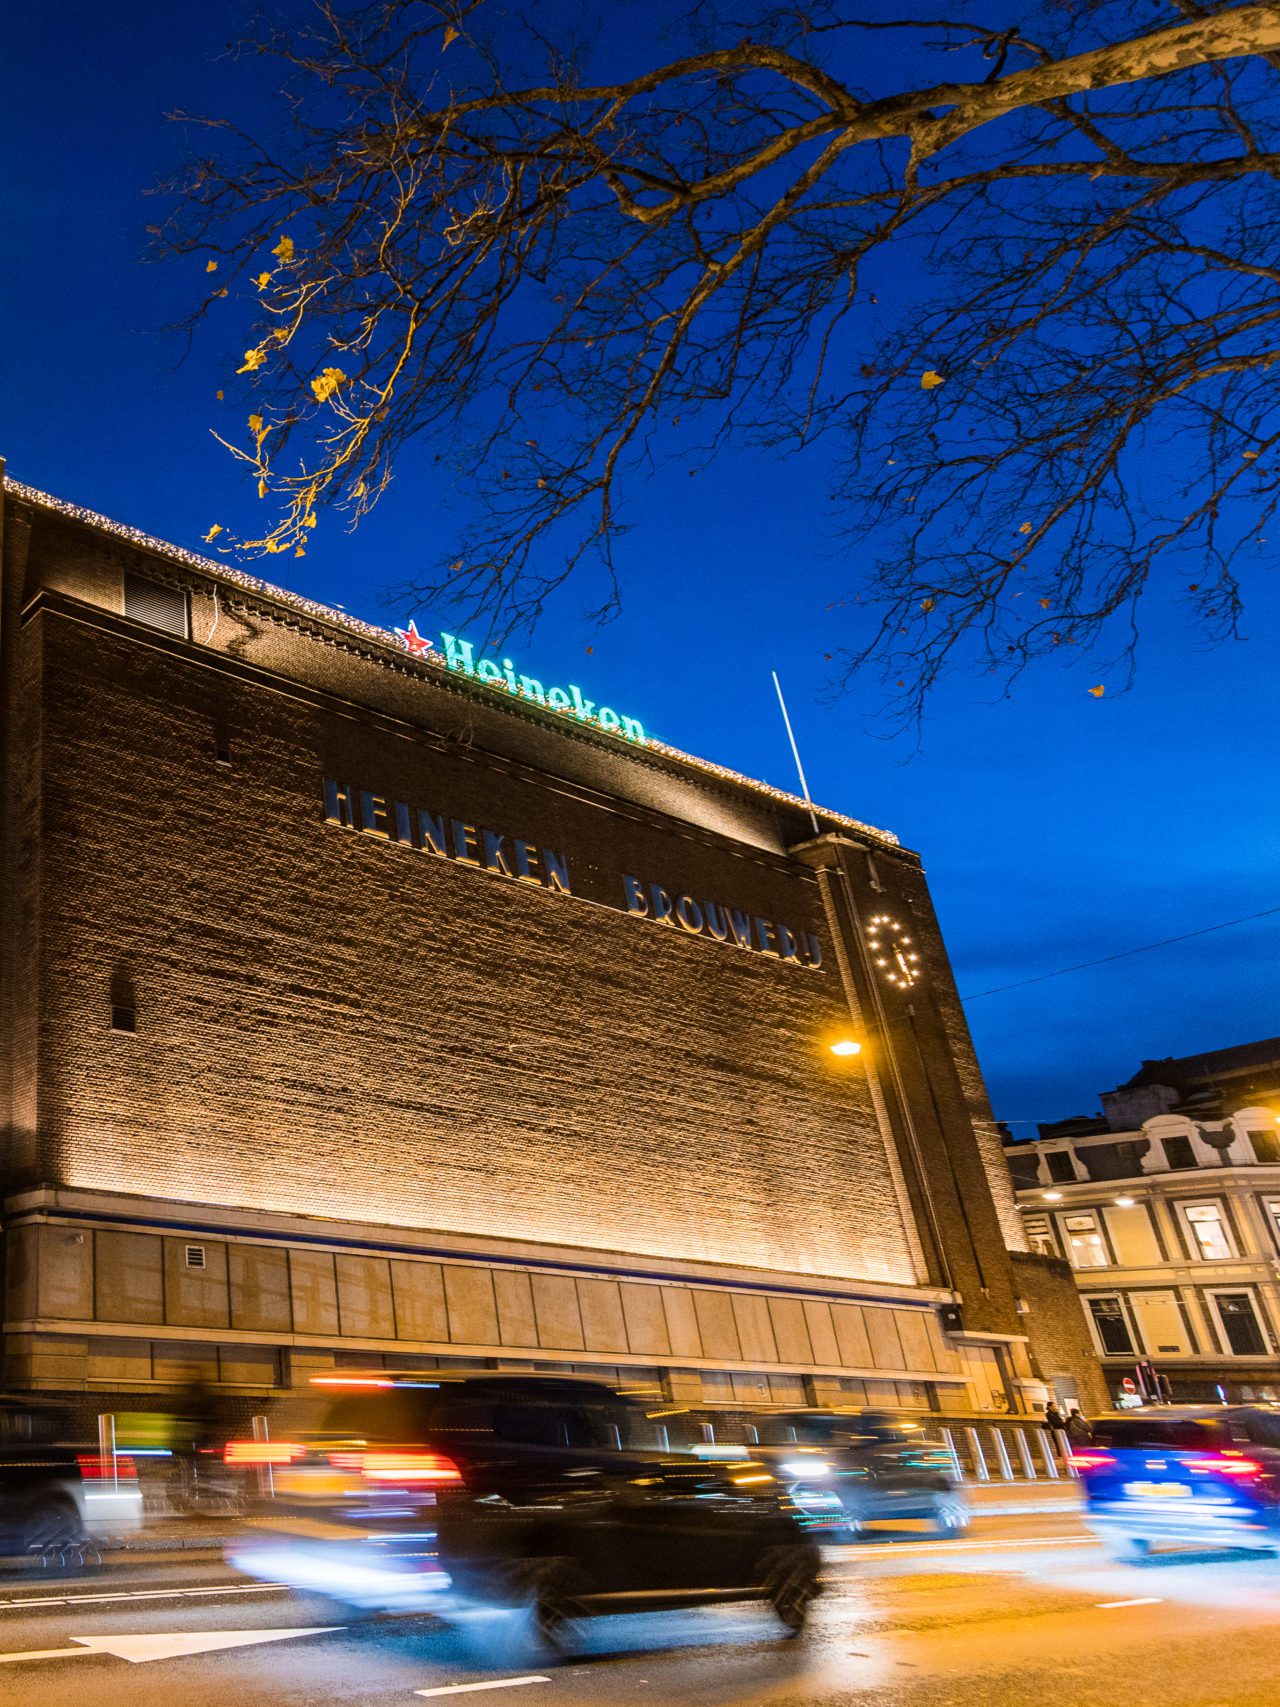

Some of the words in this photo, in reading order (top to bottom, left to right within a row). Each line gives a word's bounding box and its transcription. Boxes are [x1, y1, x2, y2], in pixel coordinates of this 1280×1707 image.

[440, 631, 647, 747] Heineken
[322, 778, 572, 895] HEINEKEN
[620, 872, 822, 969] BROUWERIJ
